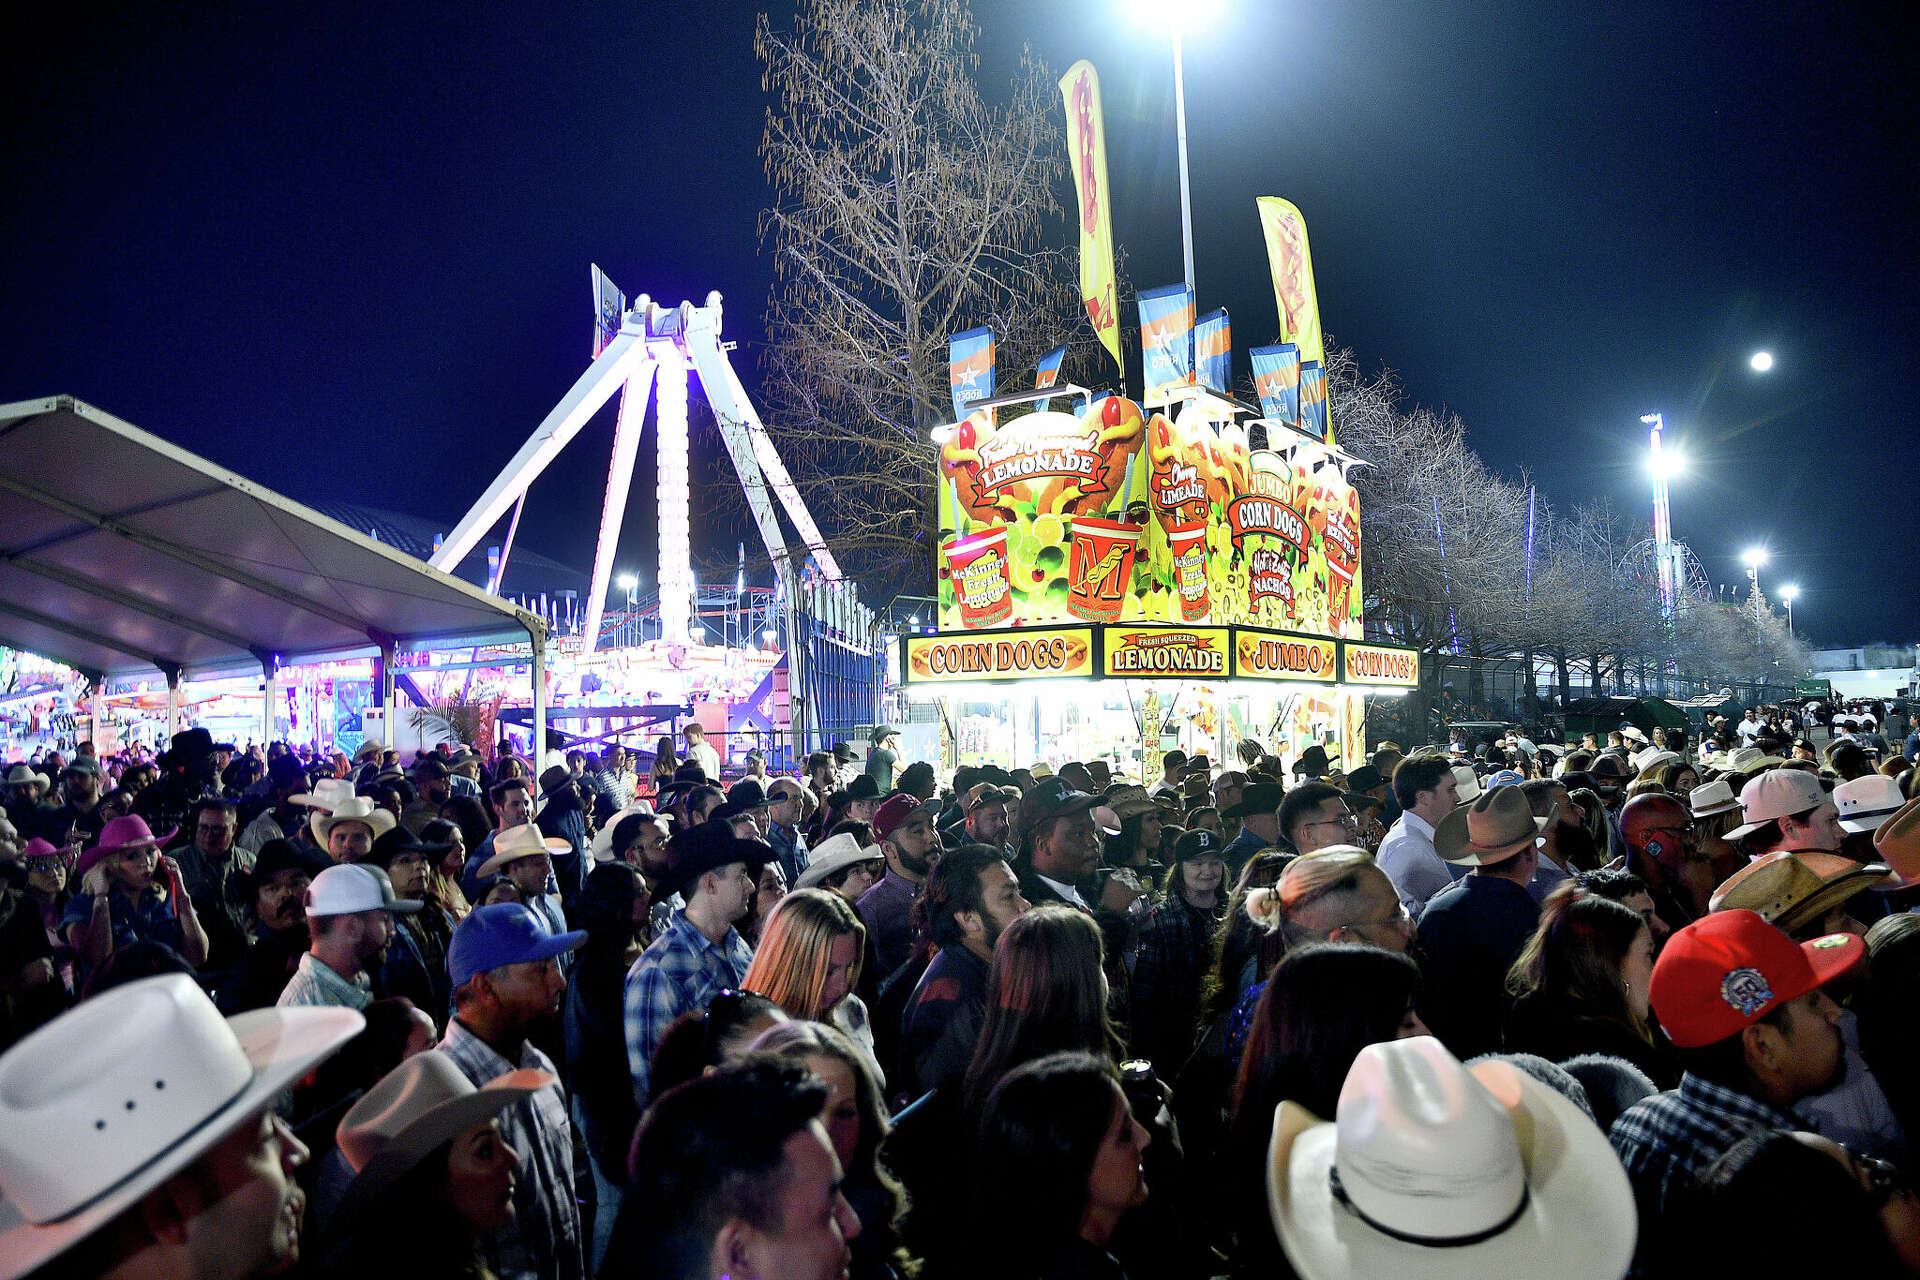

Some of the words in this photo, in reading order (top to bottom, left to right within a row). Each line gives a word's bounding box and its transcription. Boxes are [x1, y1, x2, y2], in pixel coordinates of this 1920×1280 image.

[981, 453, 1095, 489] LEMONADE
[1160, 484, 1206, 505] LIMEADE
[1249, 473, 1291, 505] JUMBO
[1239, 500, 1272, 530] CORN
[1272, 504, 1303, 545] DOGS
[1252, 575, 1292, 602] NACHOS
[1138, 638, 1160, 646] FRESH
[1160, 634, 1197, 644] SQUEEZED
[930, 643, 993, 674] CORN
[996, 637, 1066, 671] DOGS
[1112, 646, 1224, 674] LEMONADE
[1255, 640, 1323, 674] JUMBO
[1355, 650, 1383, 678] CORN
[1384, 653, 1411, 680] DOGS
[1197, 831, 1209, 847] B
